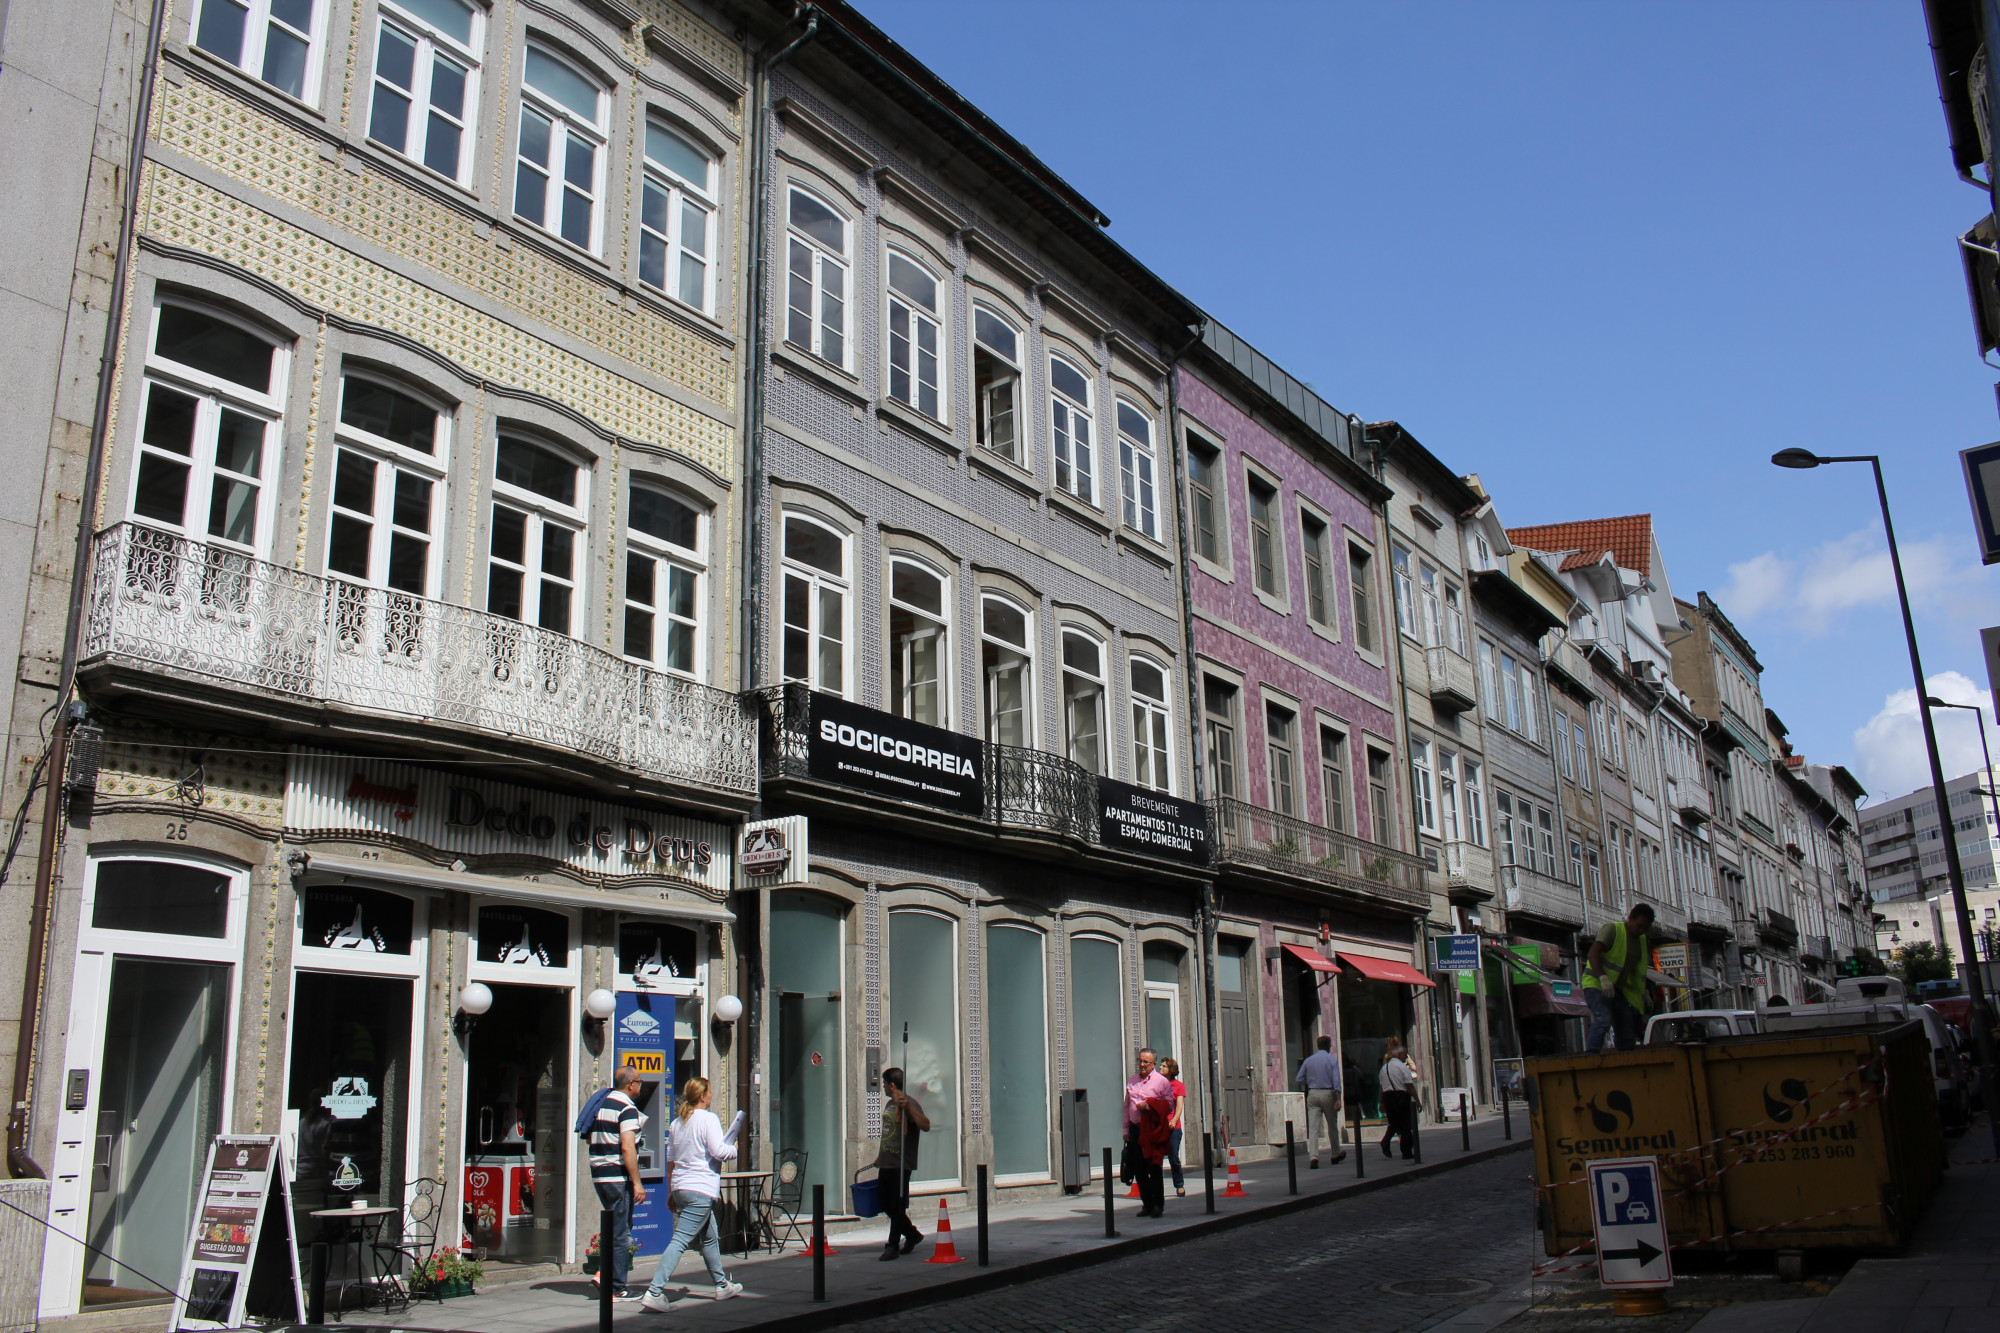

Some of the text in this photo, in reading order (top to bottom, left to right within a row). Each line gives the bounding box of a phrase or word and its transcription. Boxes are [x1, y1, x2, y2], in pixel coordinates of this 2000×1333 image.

[820, 719, 976, 779] SOCICORREIA
[1131, 794, 1180, 818] BREVEMENTE
[166, 822, 187, 840] 25
[446, 785, 712, 866] Dedo de Deus
[1105, 806, 1204, 841] APARTAMENTOS T1, T2 E T3
[1120, 824, 1193, 852] ESPAÇO COMERCIAL
[1659, 959, 1684, 967] OURO
[627, 1017, 653, 1027] Euronet
[627, 1056, 661, 1070] ATM
[1556, 1130, 1676, 1155] Semural
[1758, 1144, 1855, 1162] 253 283 960
[1601, 1171, 1630, 1223] P
[199, 1242, 246, 1253] SUGESTÃO DO DIA
